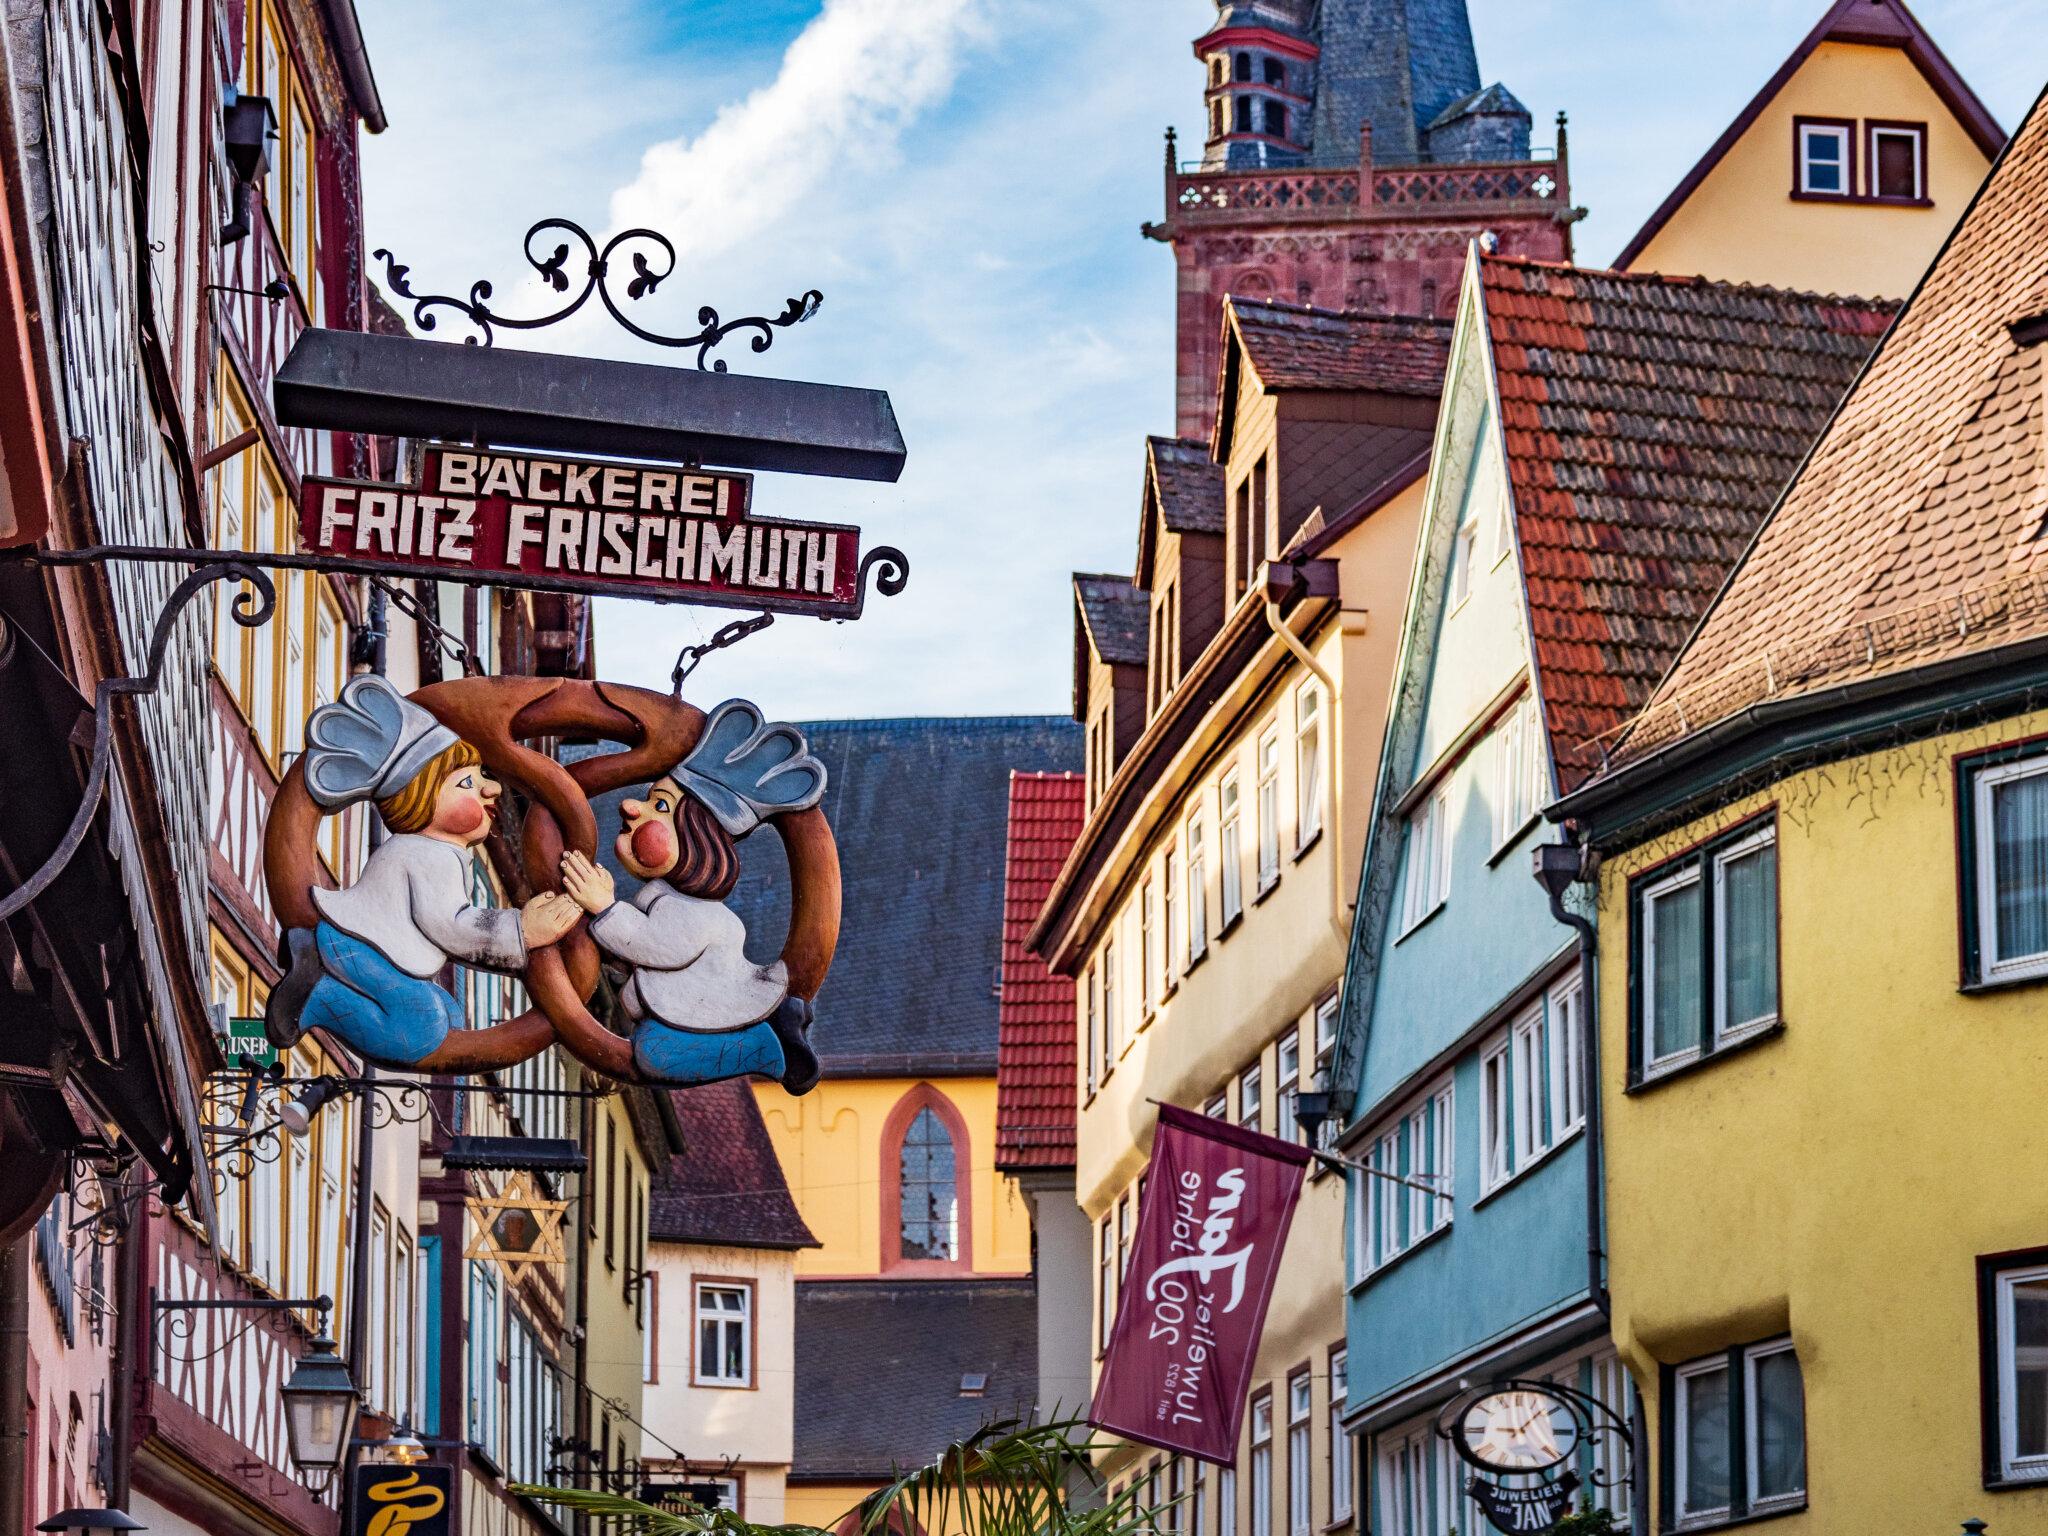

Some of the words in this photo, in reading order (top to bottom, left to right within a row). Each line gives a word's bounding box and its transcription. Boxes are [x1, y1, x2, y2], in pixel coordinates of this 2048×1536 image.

[438, 452, 730, 517] BÄCKEREI
[319, 487, 477, 562] FRITZ
[506, 504, 838, 596] FRISCHMUTH
[1490, 1483, 1563, 1501] JUWELIER
[1511, 1500, 1553, 1531] JAN
